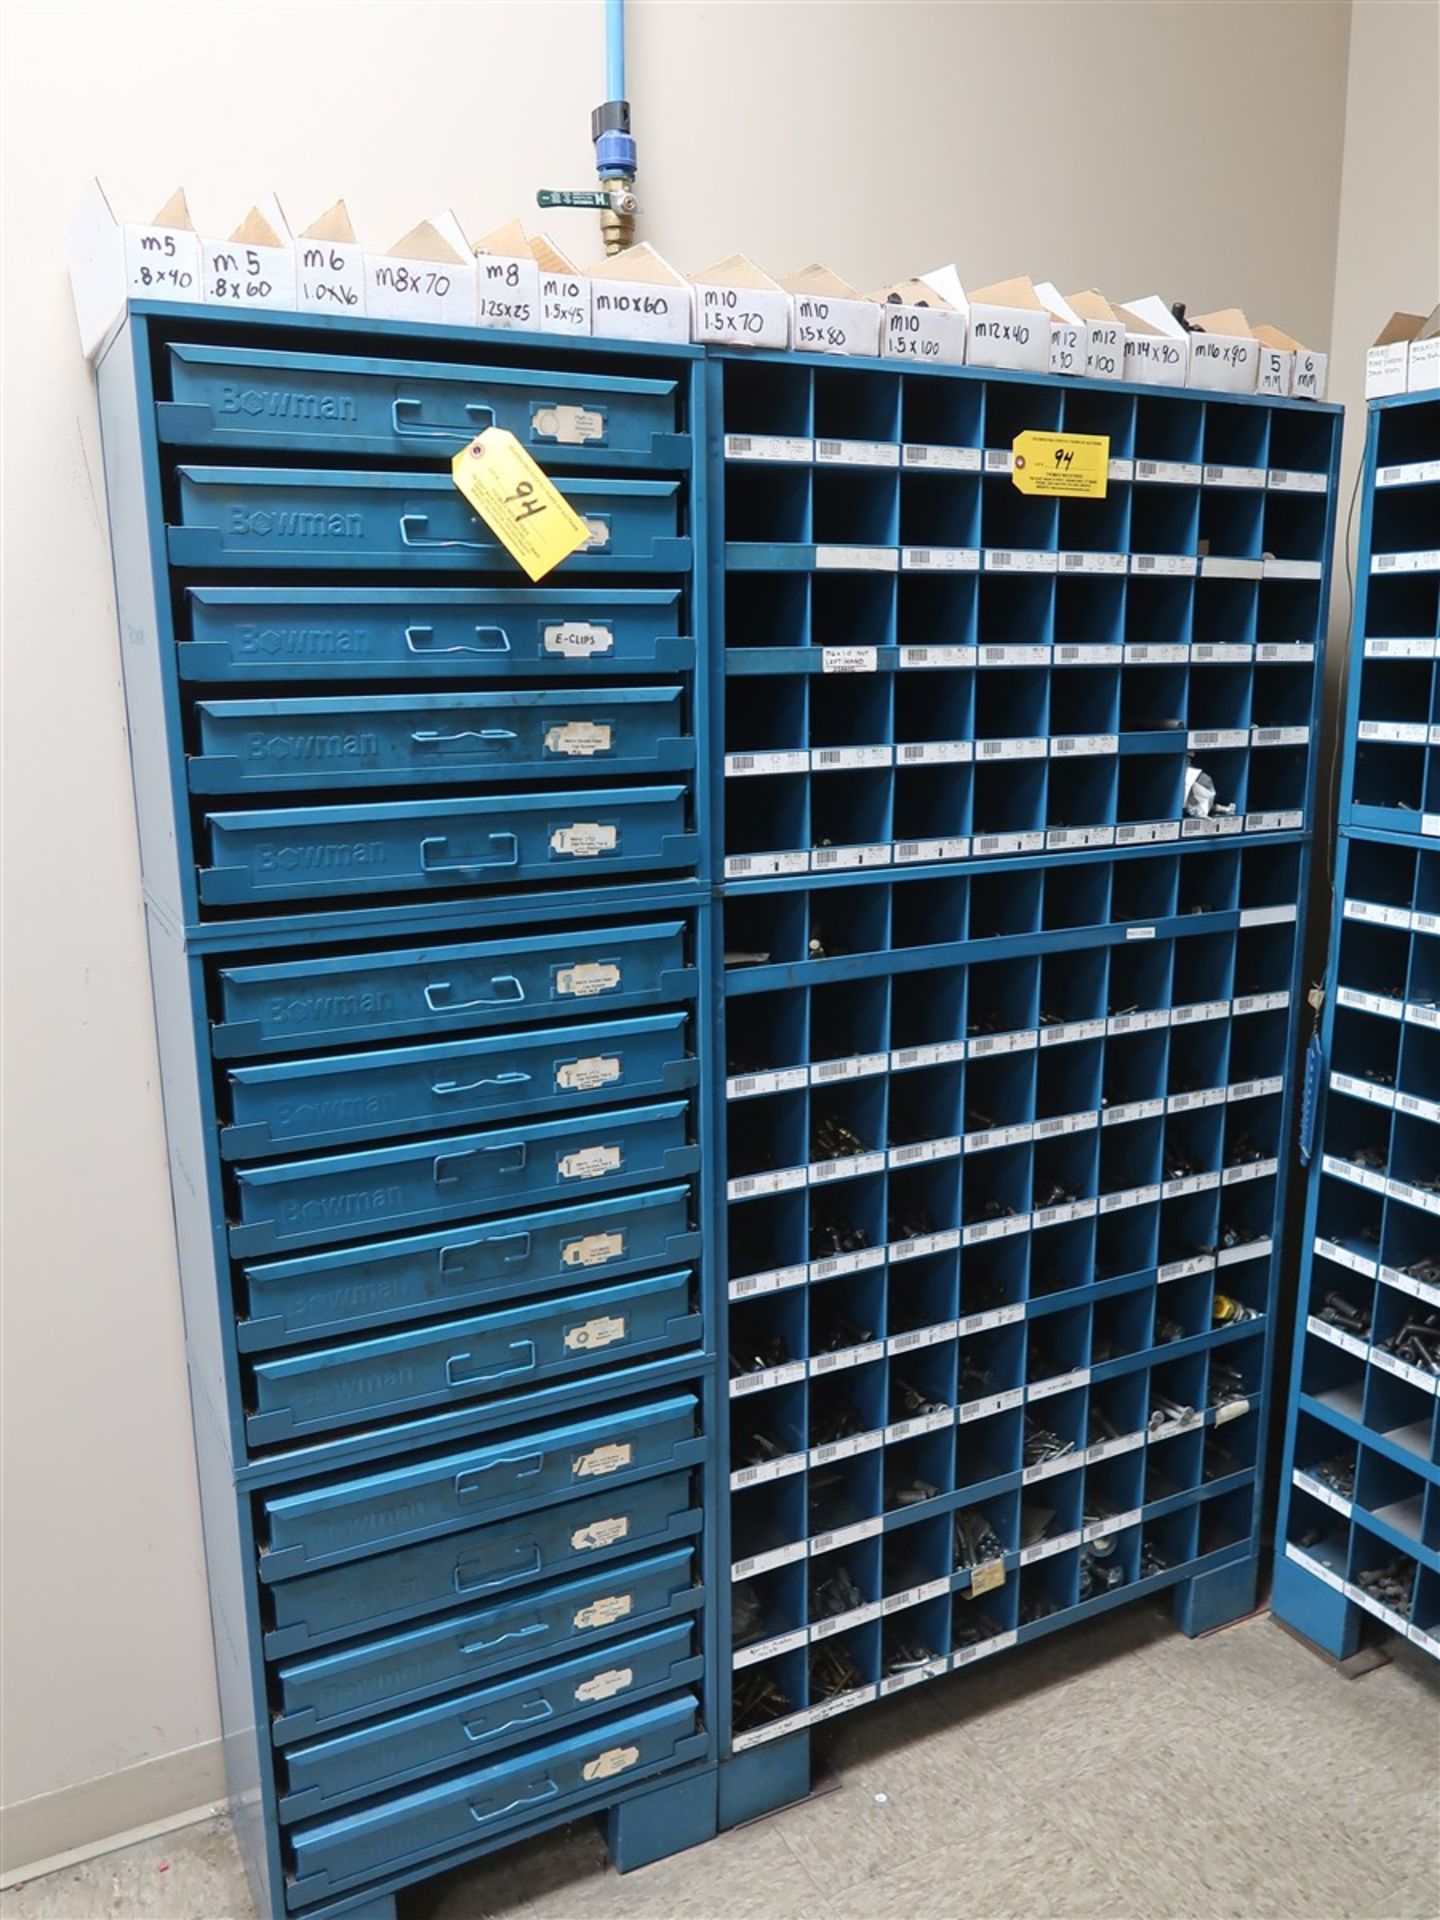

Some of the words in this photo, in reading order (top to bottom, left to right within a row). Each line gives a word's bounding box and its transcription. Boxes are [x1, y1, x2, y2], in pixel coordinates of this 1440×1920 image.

[218, 386, 358, 422] Bowman
[1054, 448, 1075, 472] 94
[503, 481, 547, 523] 94
[228, 503, 365, 538] Bowman
[235, 624, 369, 655] Bowman
[555, 633, 596, 646] E-CLIPS
[245, 731, 380, 760] Bowman
[254, 840, 387, 873] Bowman
